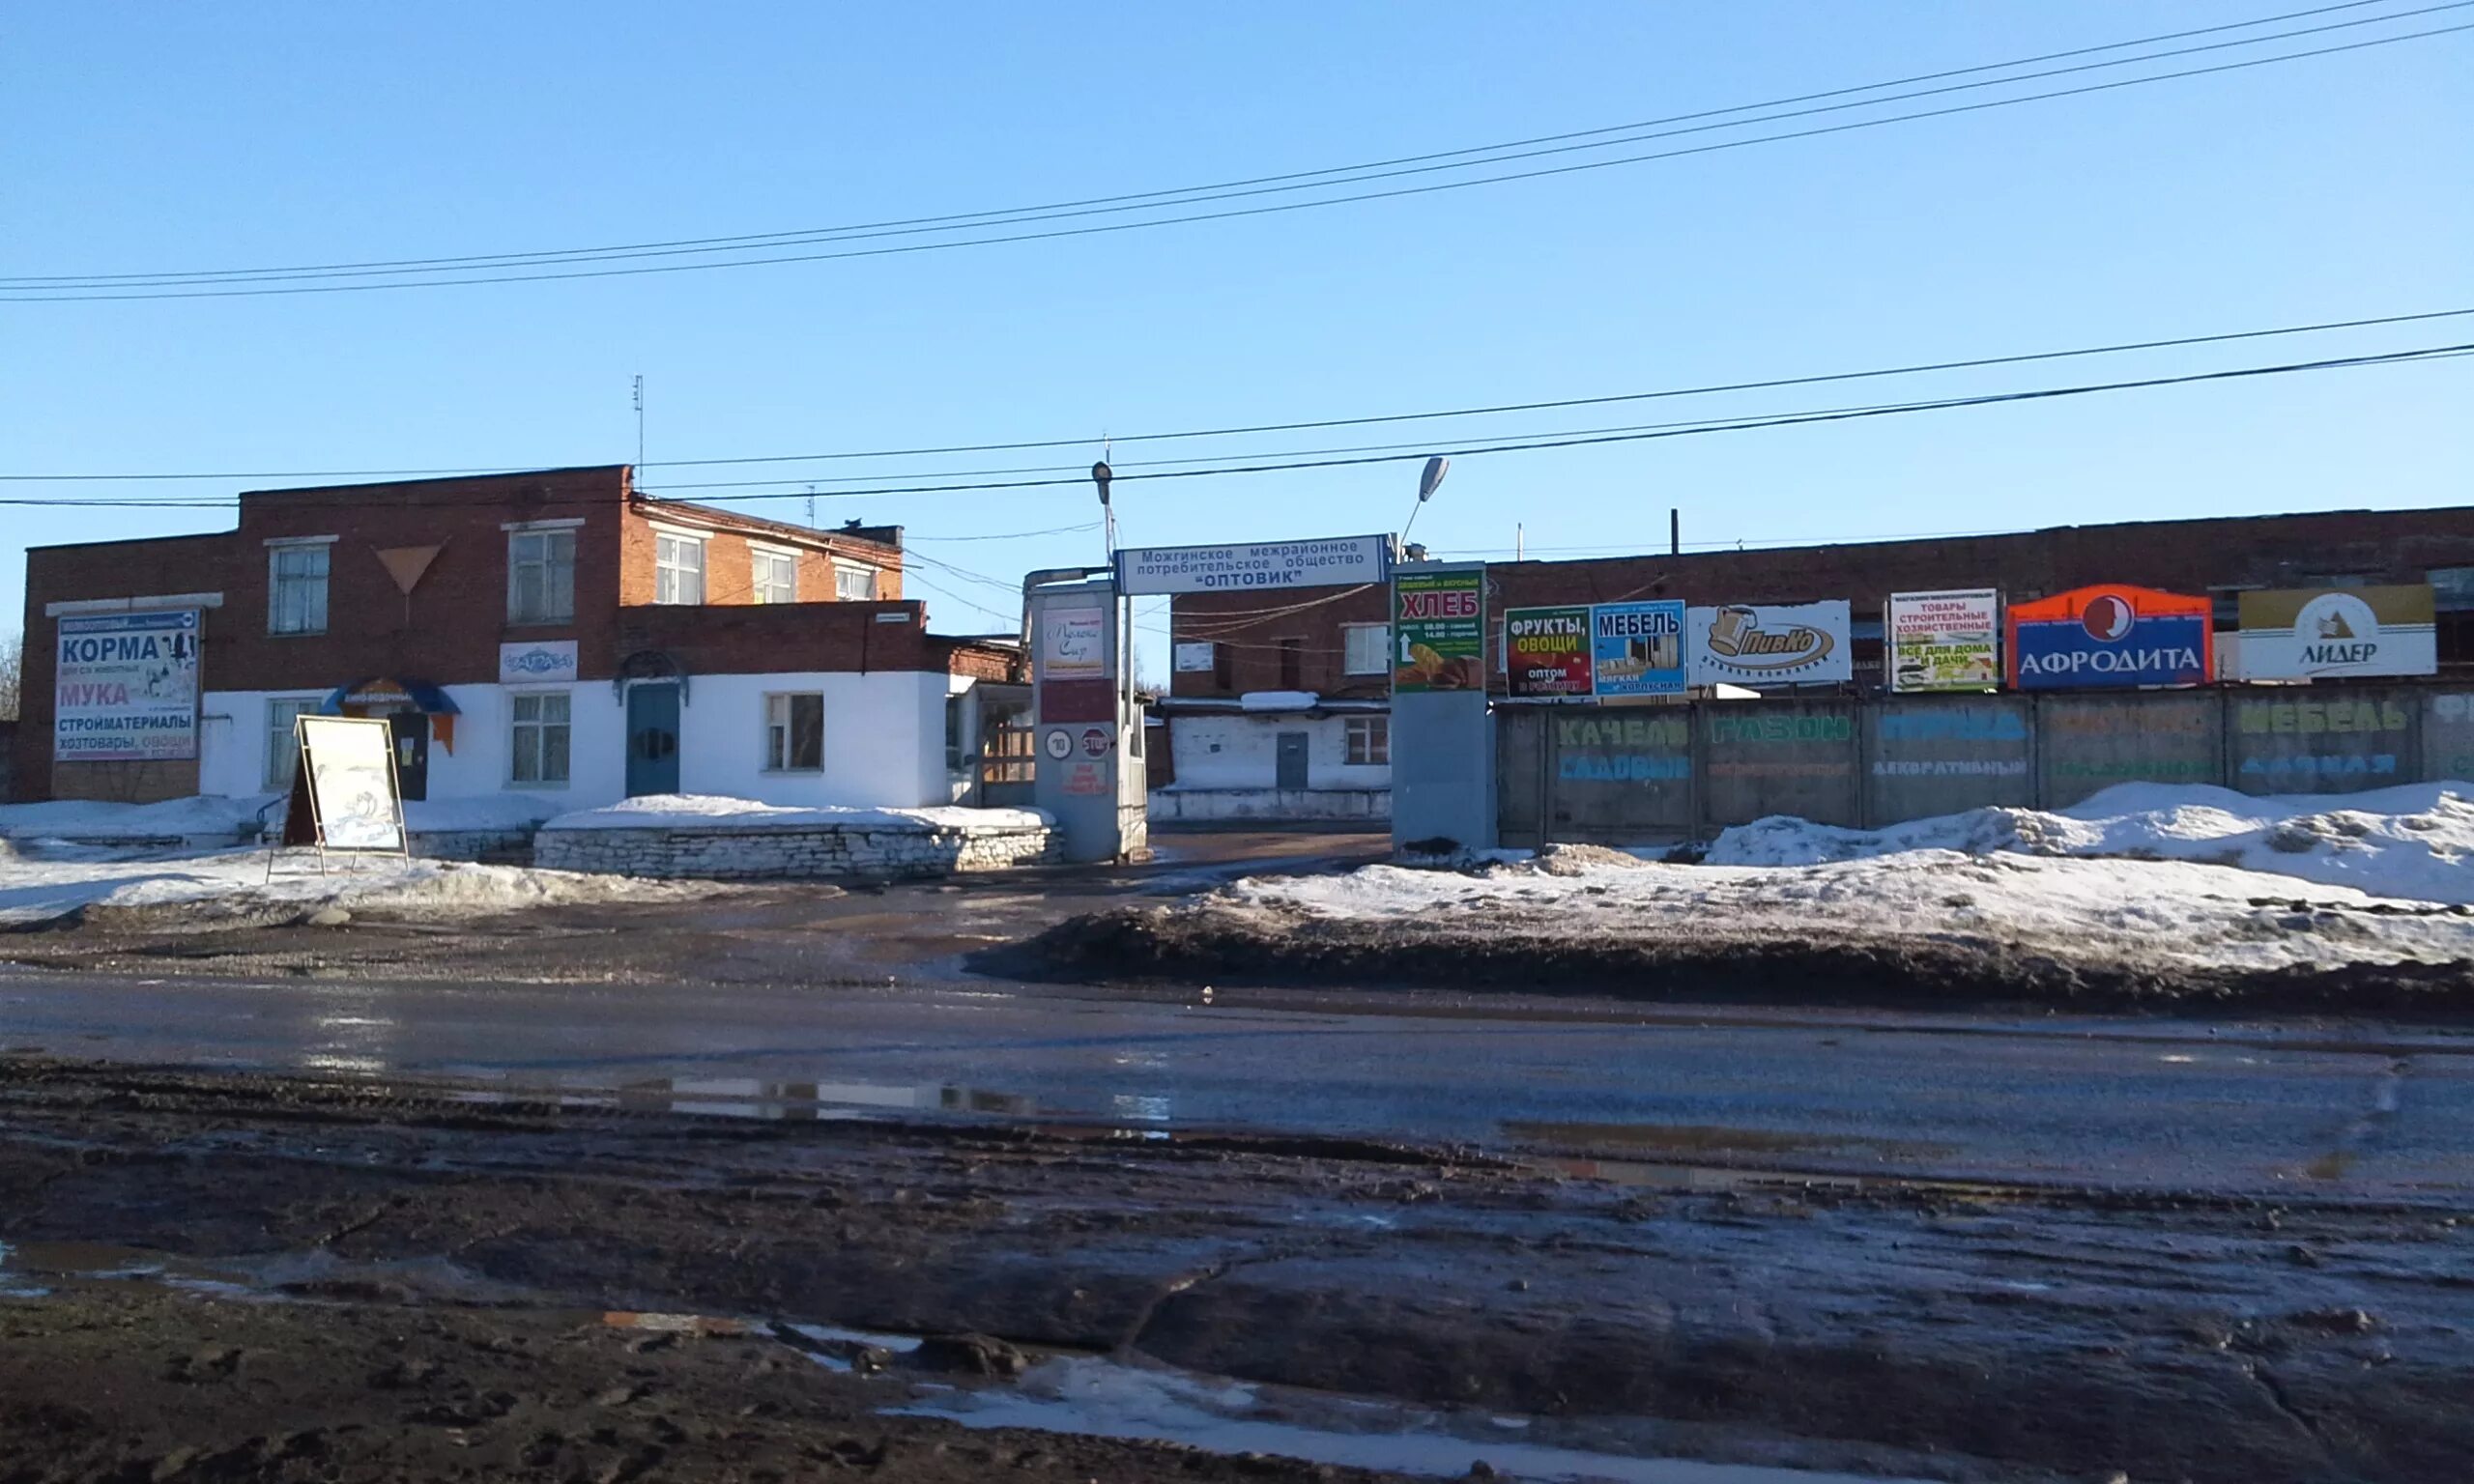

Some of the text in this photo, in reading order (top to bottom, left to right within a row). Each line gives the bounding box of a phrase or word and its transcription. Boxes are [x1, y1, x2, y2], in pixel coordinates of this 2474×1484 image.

[1136, 554, 1365, 577] потребительское общество
[1141, 549, 1233, 563] Можгинское
[1400, 590, 1479, 619] ХЛЕБ
[1920, 602, 1966, 613] ТОВАРЫ
[1510, 616, 1586, 636] ФРУКТЫ,
[1597, 612, 1682, 638] МЕБЕЛЬ
[1896, 621, 1992, 634] ХОЗЯЙСТВЕННЫЕ
[1899, 612, 1988, 623] СТРОИТЕЛЬНЫЕ
[63, 636, 160, 664] КОРМА
[1517, 636, 1578, 653] ОВОЩИ
[1925, 645, 1951, 656] ДЛЯ
[1954, 643, 1992, 654] ДОМА
[2298, 642, 2377, 665] ЛИДЕР
[1933, 655, 1970, 667] ДАЧИ
[2020, 647, 2201, 674] АФРОДИТА
[1597, 674, 1640, 684] МЯГКАЯ
[60, 683, 130, 707] МУКА
[58, 715, 191, 732] СТРОЙМАТЕРИАЛЫ
[2241, 701, 2407, 733] МЕБЕЛЬ
[1712, 715, 1852, 744] ГАЗОН
